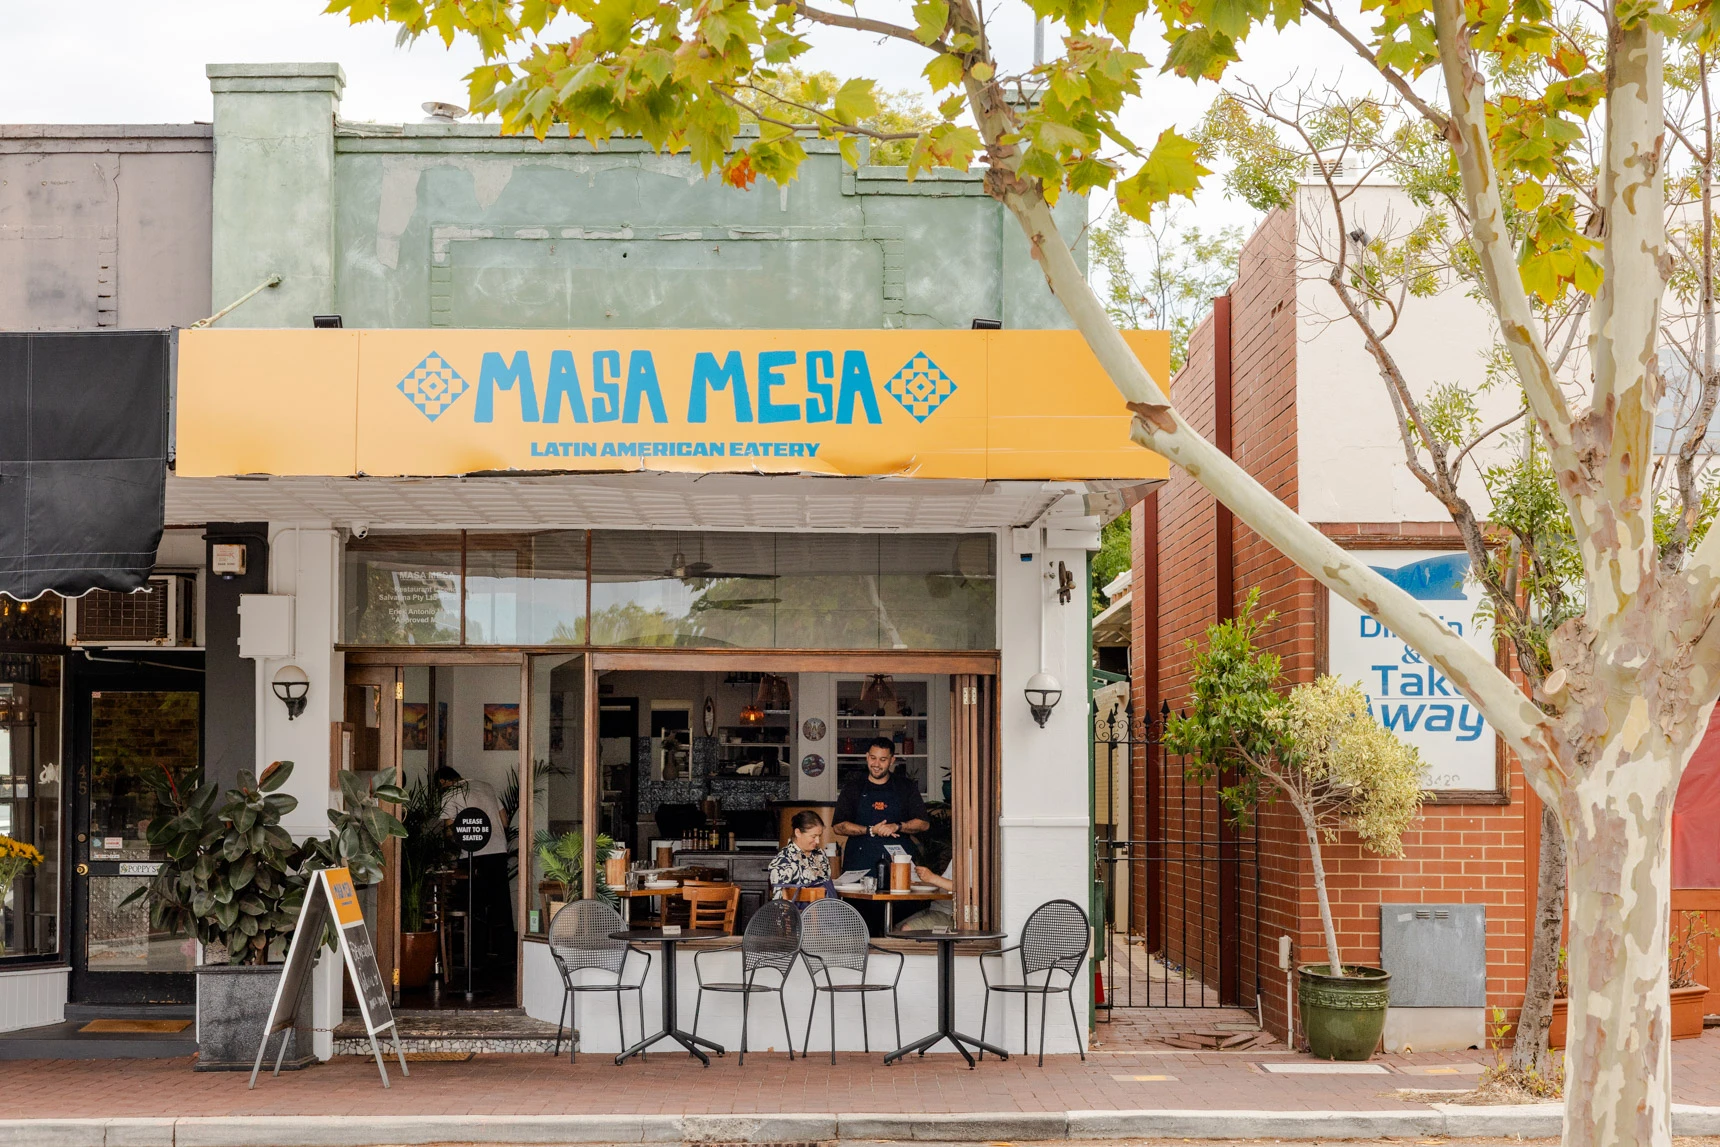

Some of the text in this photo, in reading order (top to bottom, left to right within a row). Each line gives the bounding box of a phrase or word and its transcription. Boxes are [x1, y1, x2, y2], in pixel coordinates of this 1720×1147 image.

[473, 349, 883, 424] MASA MESA
[530, 441, 820, 458] LATIN AMERICAN EATERY
[399, 571, 427, 580] MASA
[412, 594, 425, 602] Pty
[1401, 644, 1425, 665] &
[1371, 665, 1464, 697] Tak
